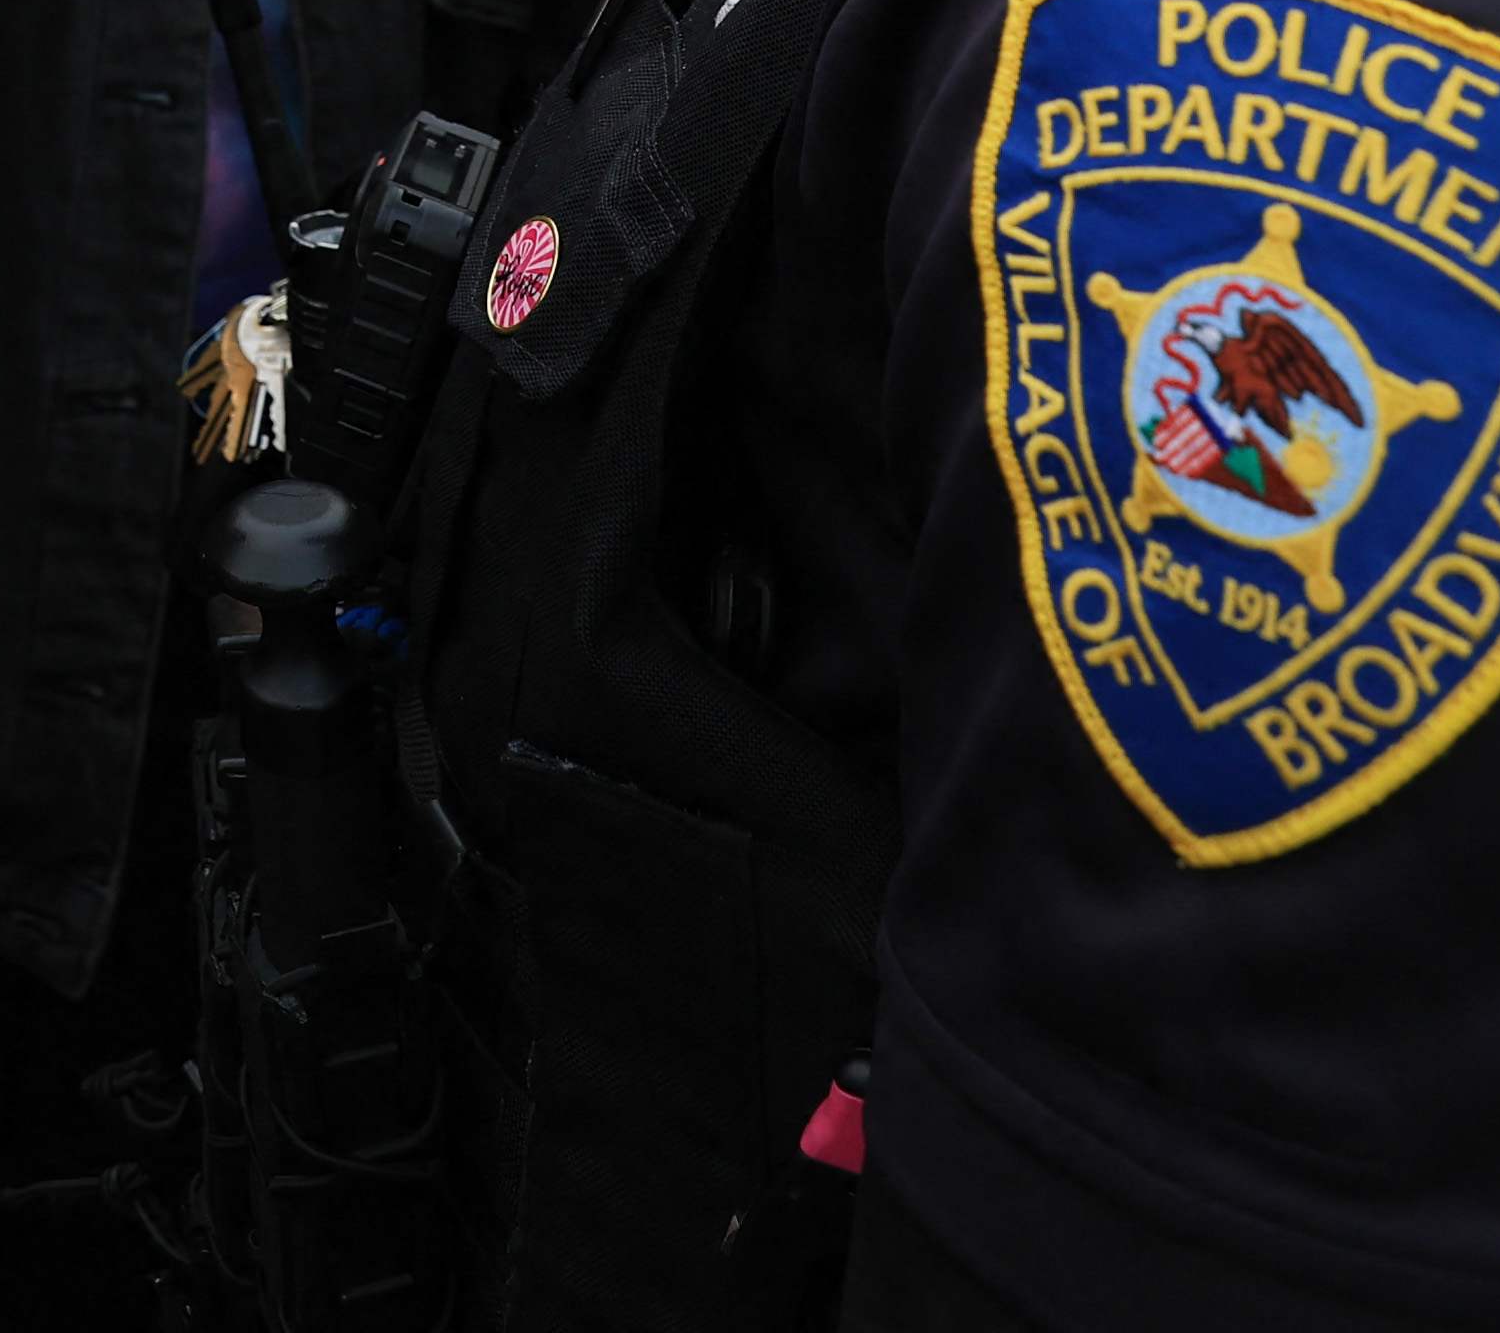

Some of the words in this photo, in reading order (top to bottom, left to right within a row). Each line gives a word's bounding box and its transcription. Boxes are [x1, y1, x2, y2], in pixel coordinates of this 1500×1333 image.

[997, 190, 1103, 550] VILLAGE
[1060, 567, 1156, 686] OF
[1140, 539, 1211, 614] Est.
[1218, 576, 1312, 651] 1914
